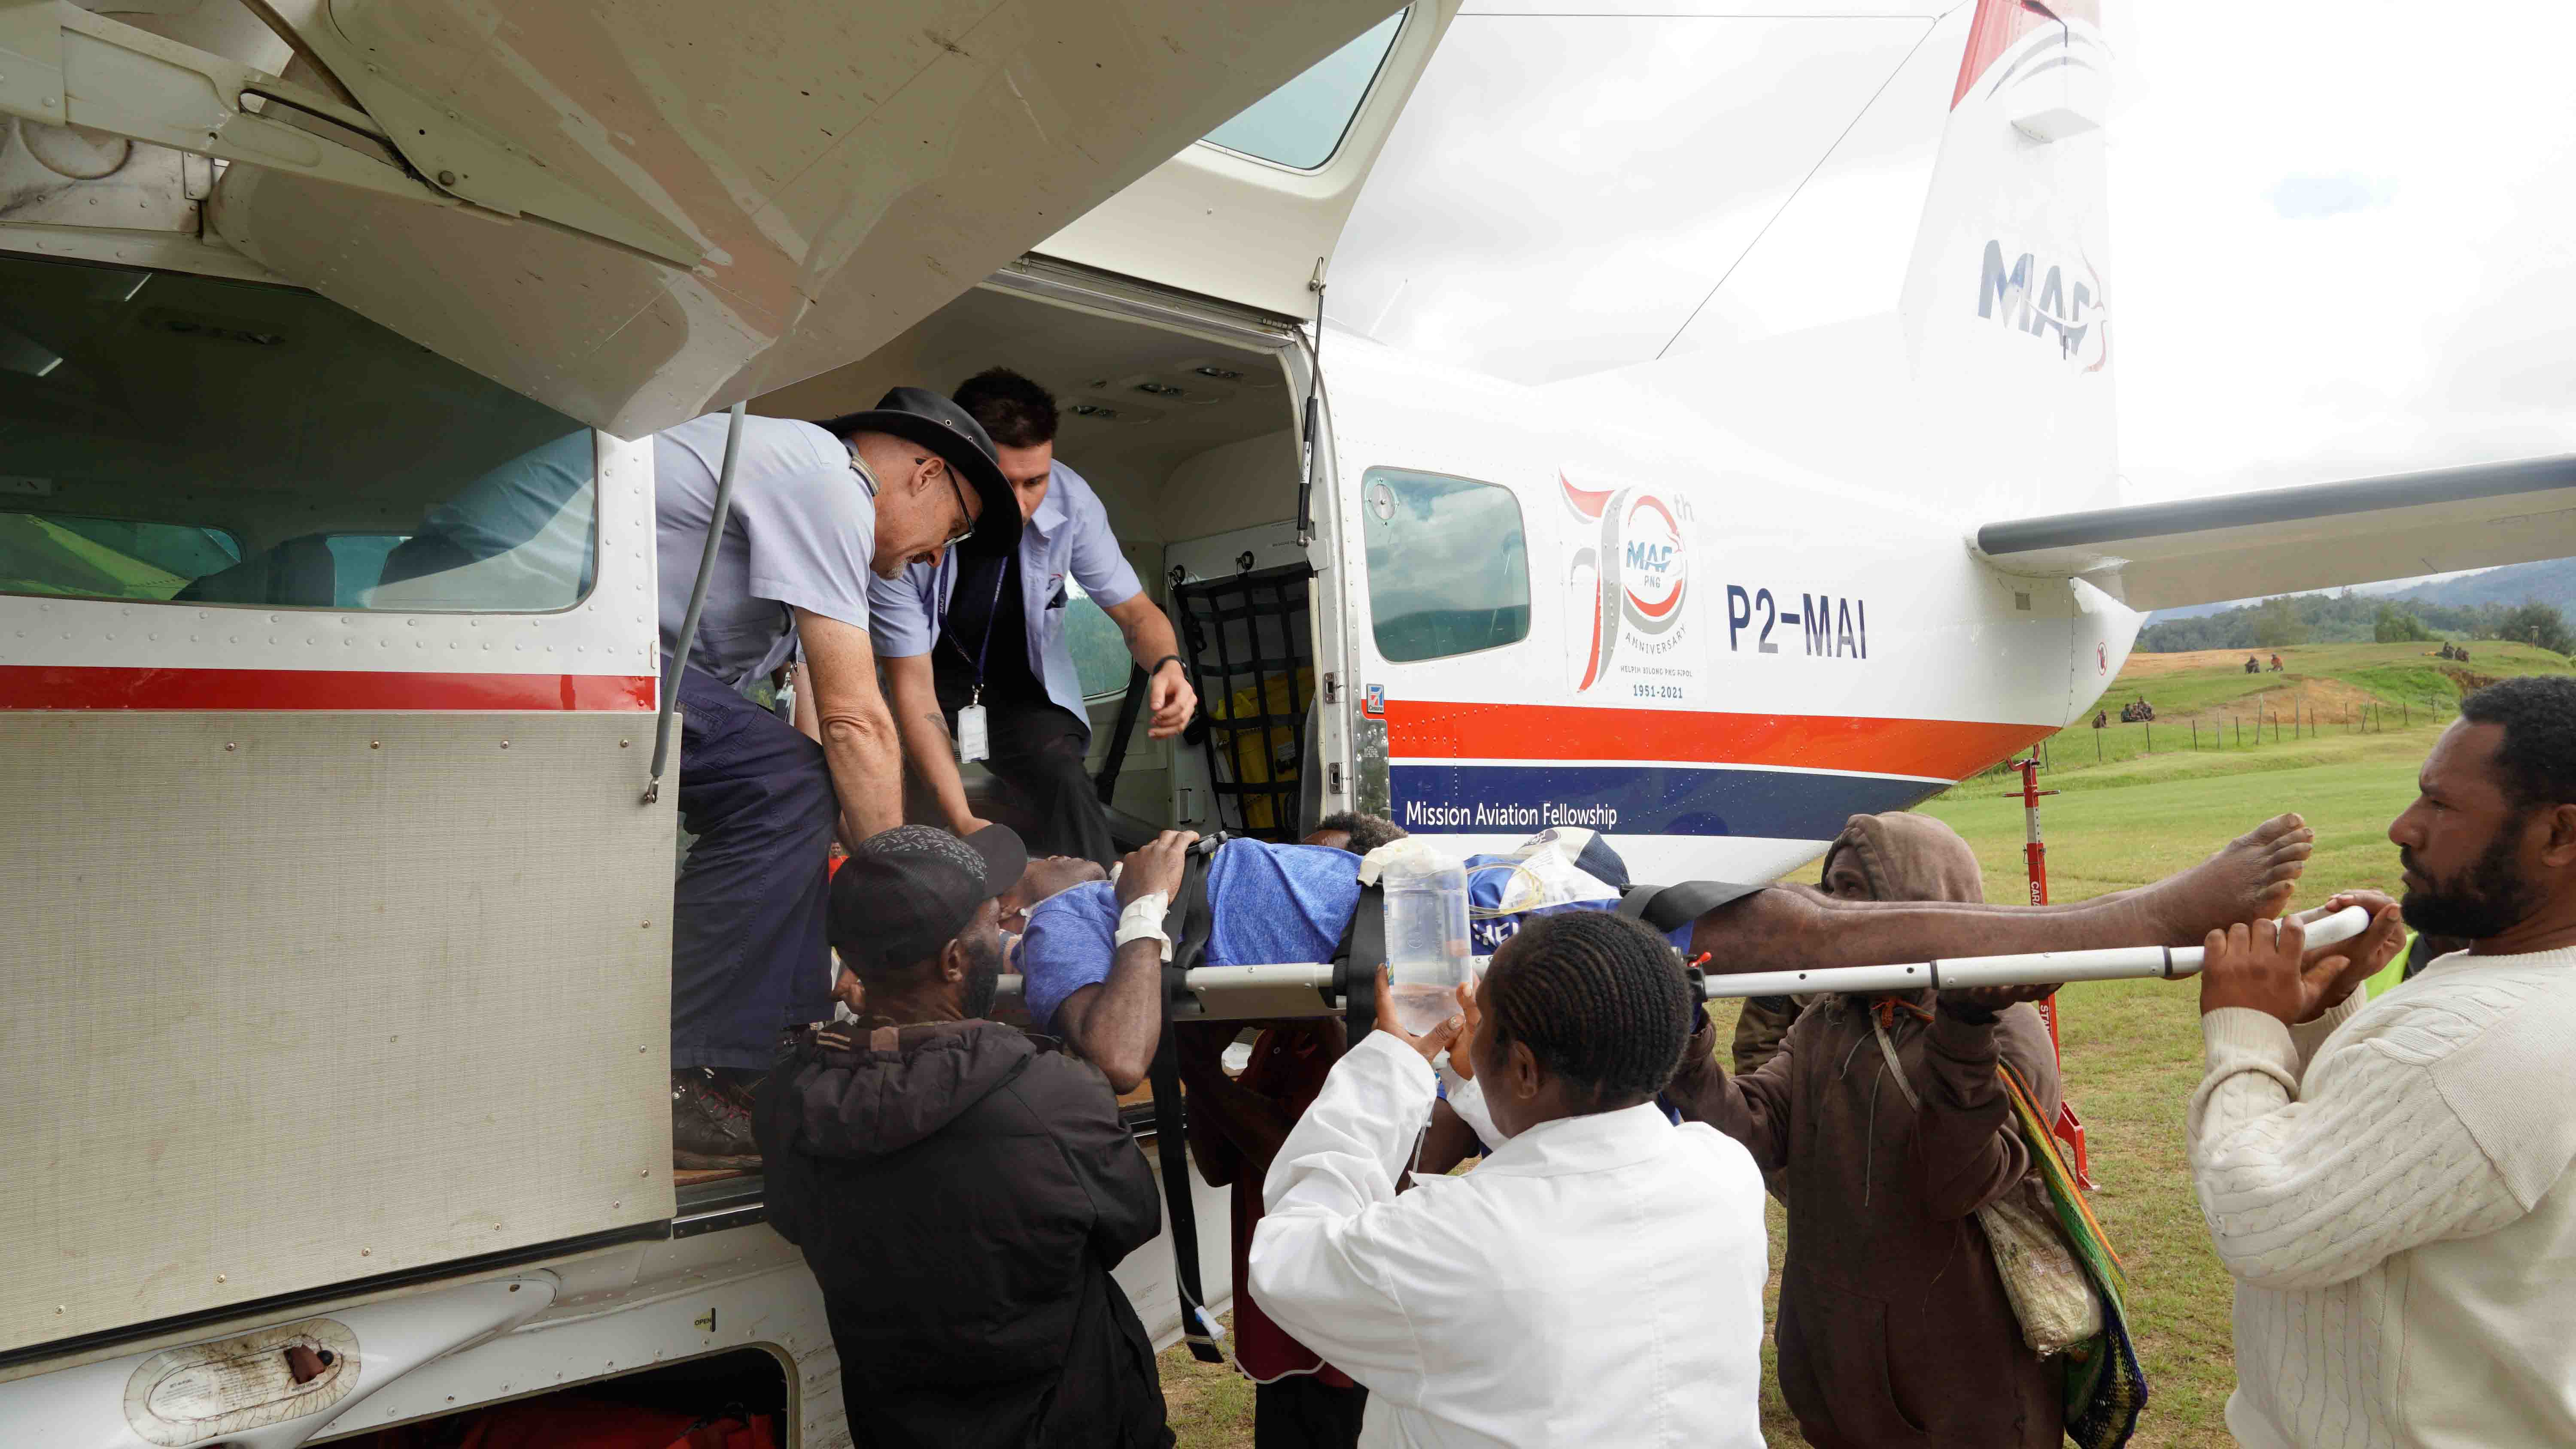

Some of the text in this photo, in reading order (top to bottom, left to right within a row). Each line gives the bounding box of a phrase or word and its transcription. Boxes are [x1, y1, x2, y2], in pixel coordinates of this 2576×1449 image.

[1644, 575, 1661, 588] PNG
[1727, 584, 1867, 659] P2-MAI
[1625, 624, 1686, 655] ANNIVERSARY
[1633, 684, 1683, 699] 1951-2021
[1406, 801, 1617, 830] Mission Aviation Fellowship
[694, 1317, 711, 1326] OPEN
